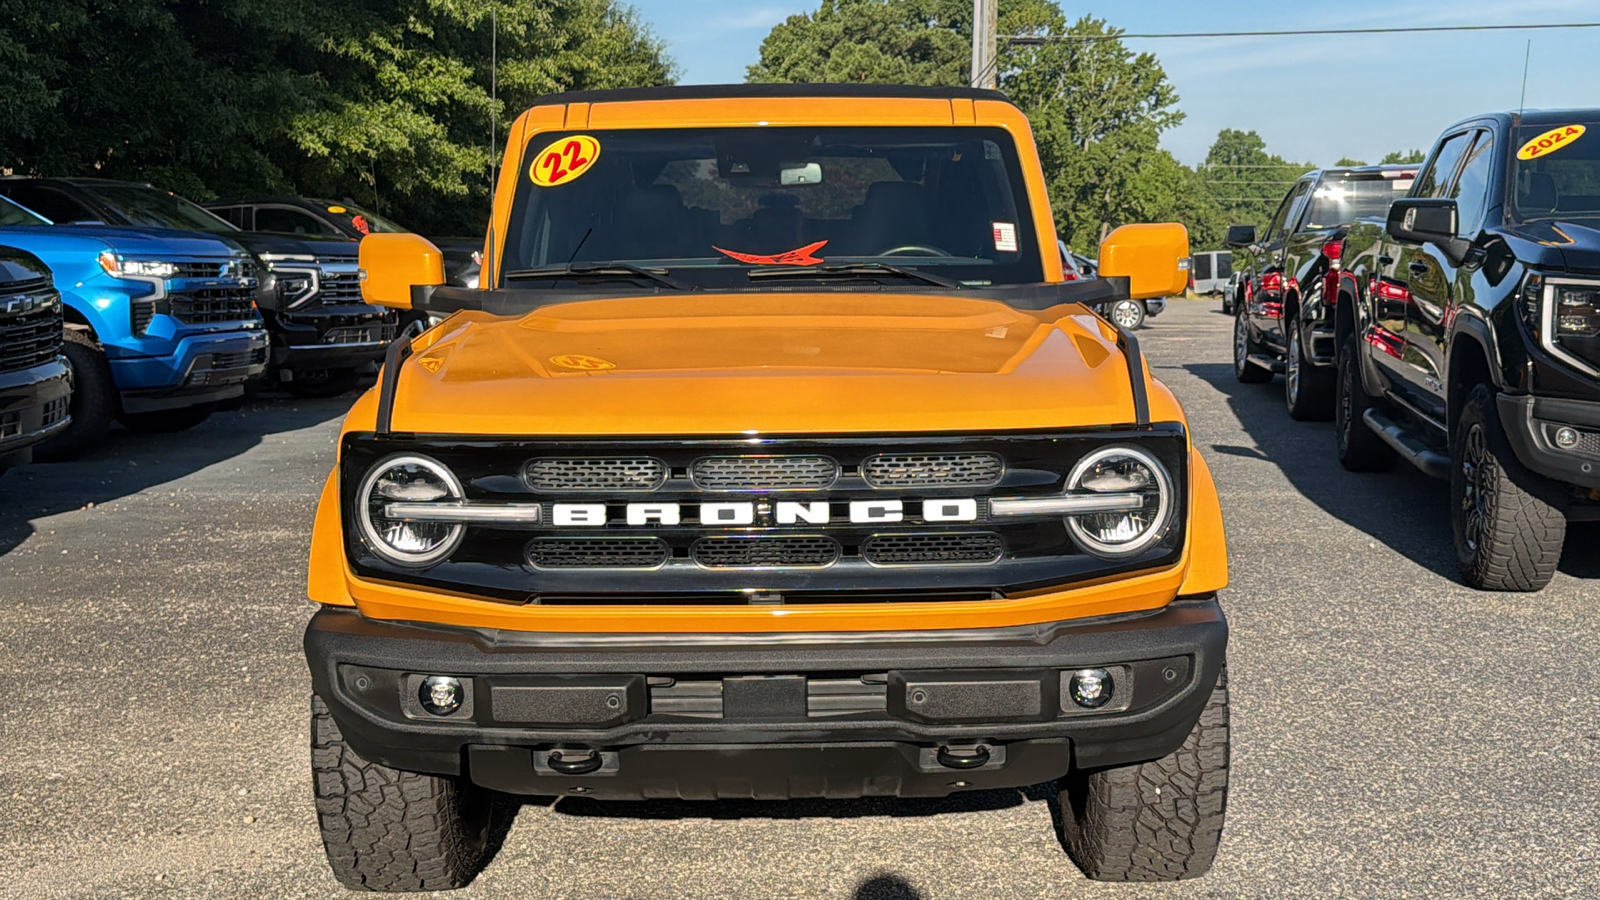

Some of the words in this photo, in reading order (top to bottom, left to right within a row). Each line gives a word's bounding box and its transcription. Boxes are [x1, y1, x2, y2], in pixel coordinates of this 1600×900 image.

[1525, 127, 1579, 156] 2024
[543, 141, 587, 183] 22
[552, 499, 977, 526] BRONCO
